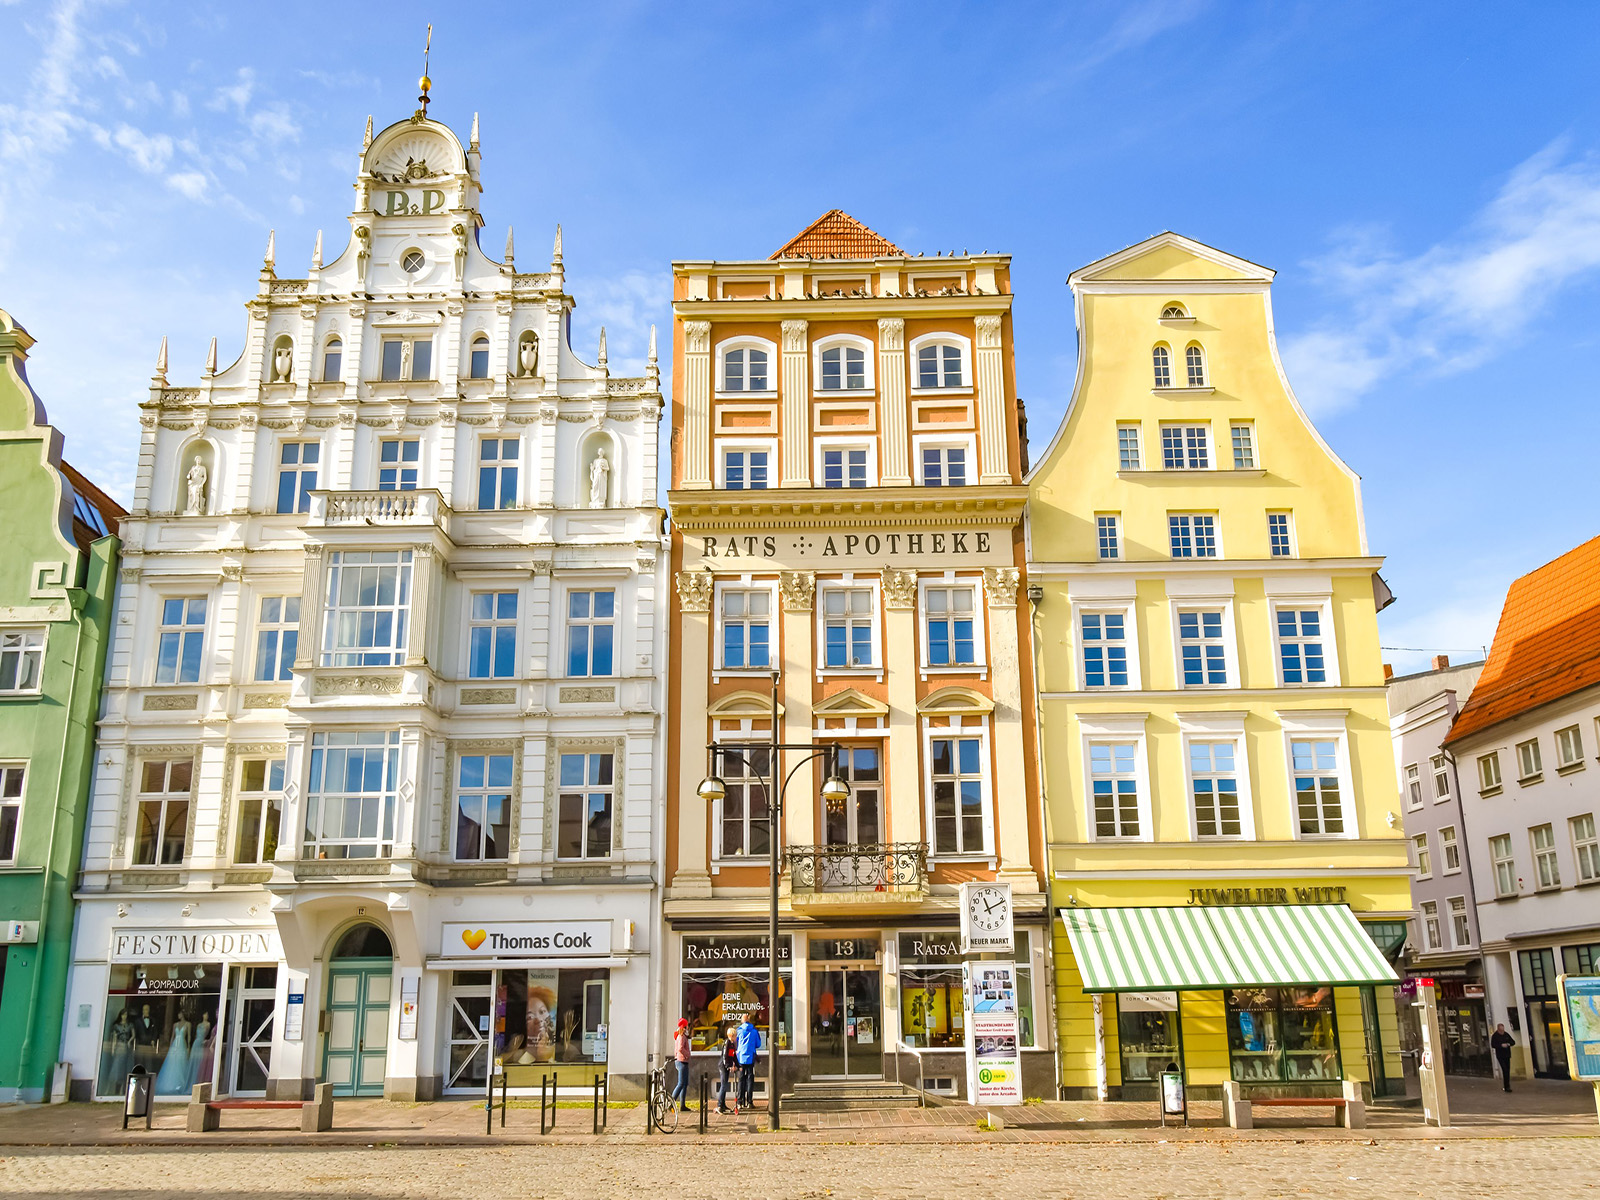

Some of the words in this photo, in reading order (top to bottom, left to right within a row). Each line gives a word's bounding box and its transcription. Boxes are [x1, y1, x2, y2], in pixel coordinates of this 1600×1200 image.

[702, 536, 776, 557] RATS
[822, 532, 990, 556] APOTHEKE
[1187, 888, 1289, 904] JUWELIER
[1293, 886, 1347, 903] WITT
[116, 934, 271, 955] FESTMODEN
[490, 933, 550, 949] Thomas
[554, 932, 592, 948] Cook
[835, 940, 854, 956] 13
[149, 980, 199, 989] POMPADOUR
[982, 1072, 989, 1080] H
